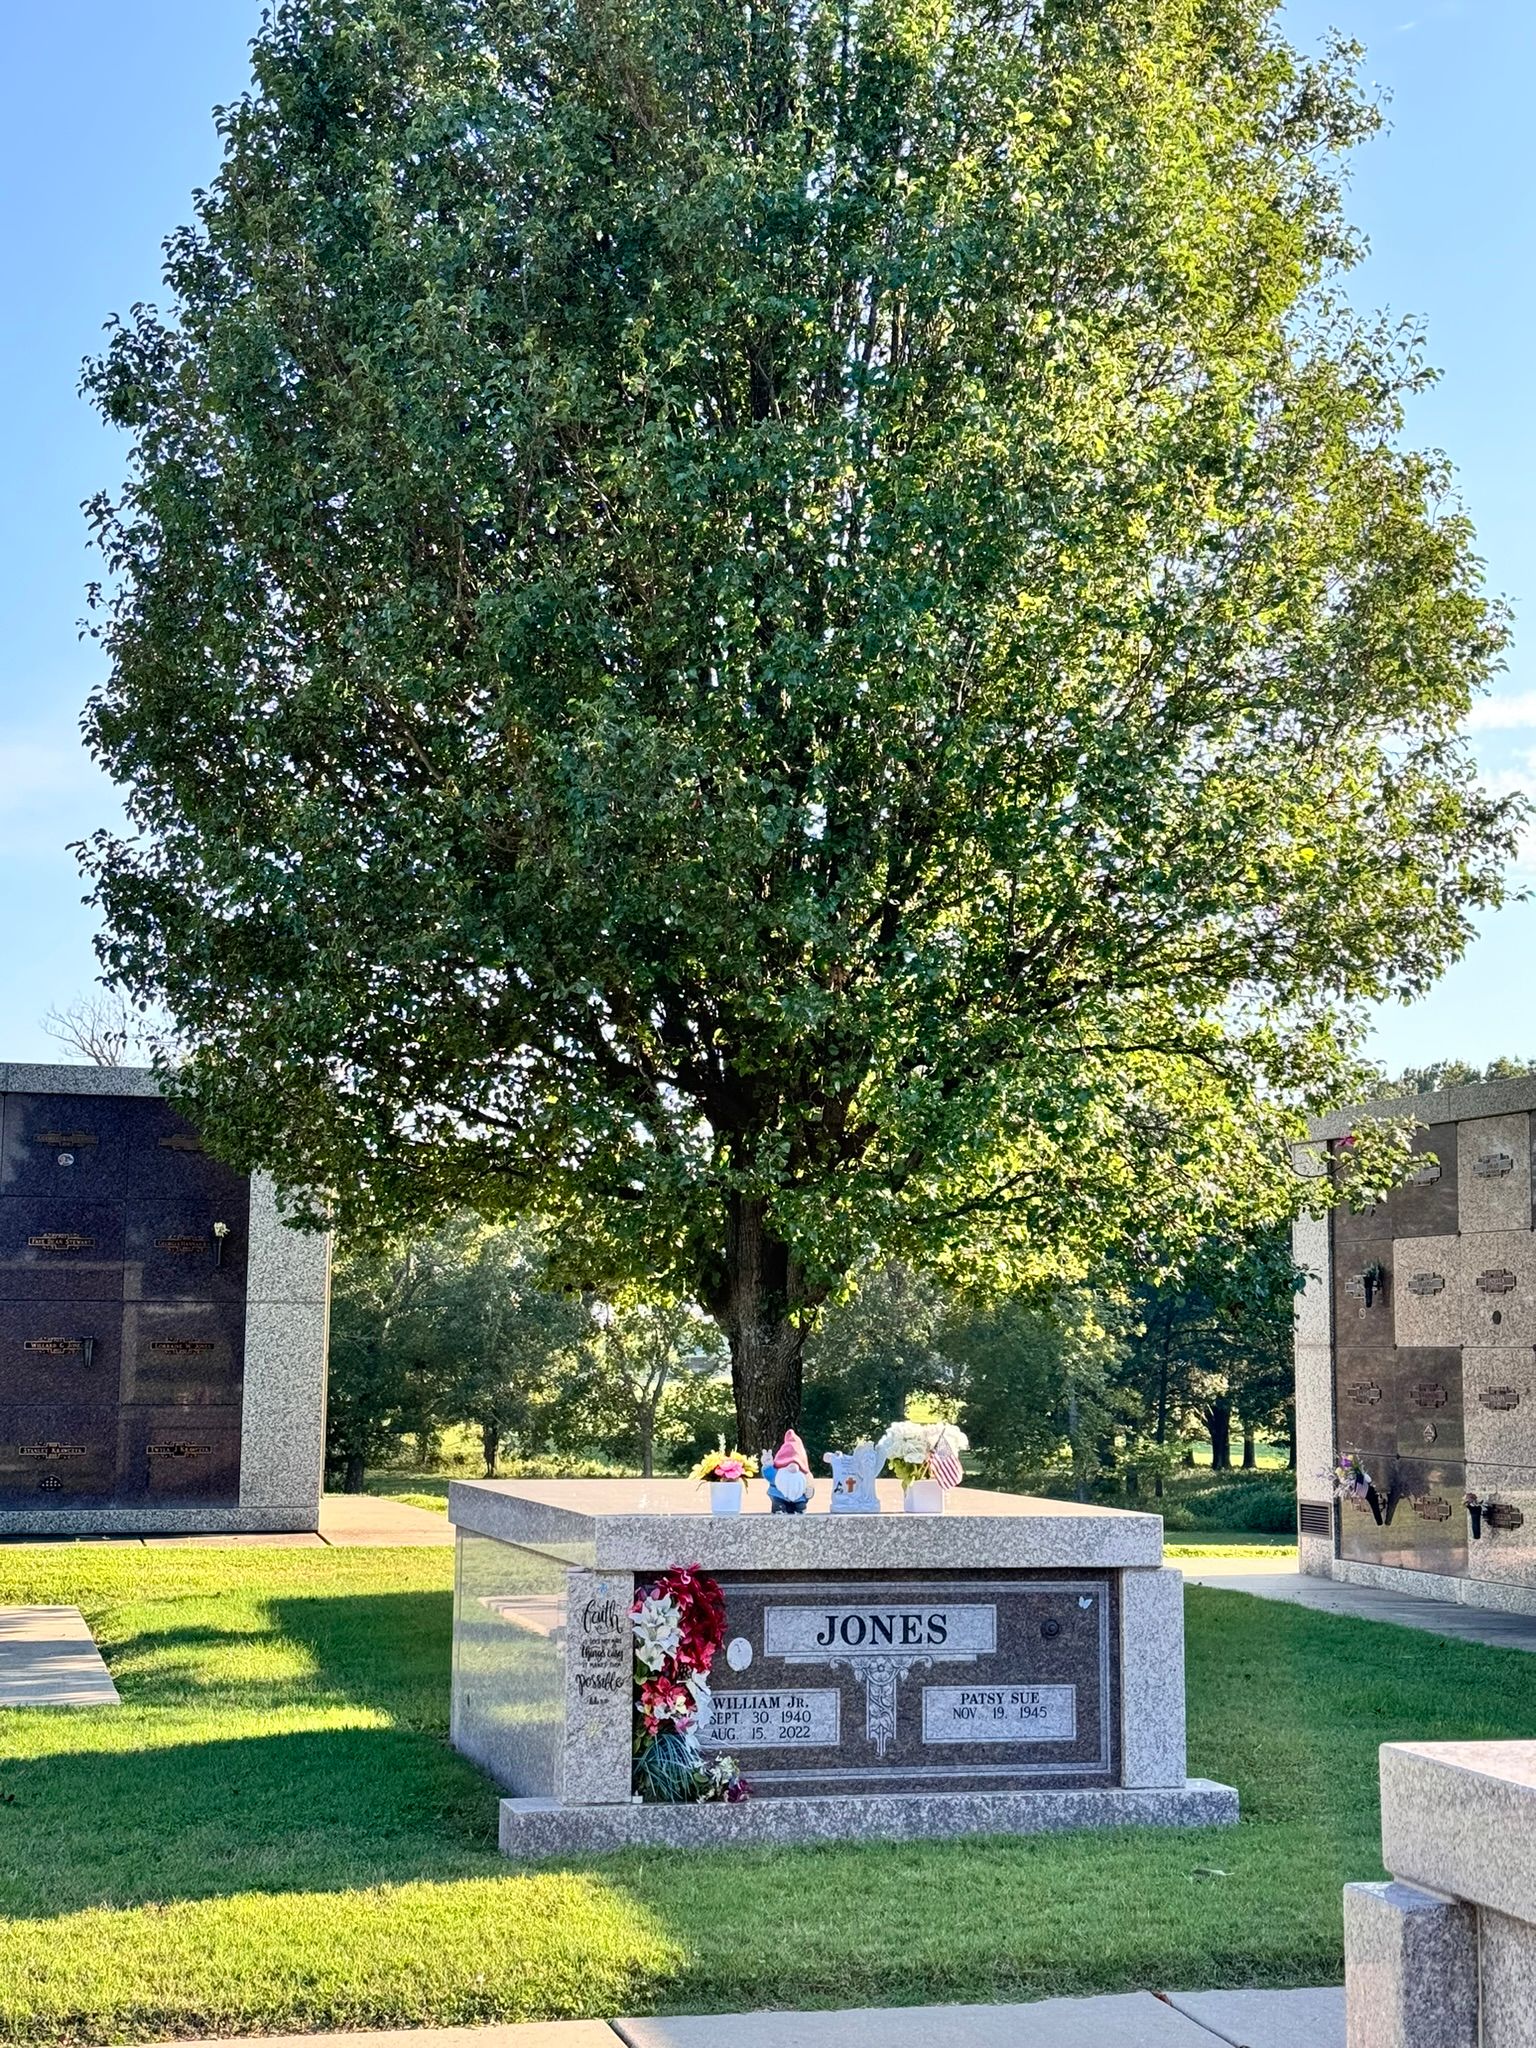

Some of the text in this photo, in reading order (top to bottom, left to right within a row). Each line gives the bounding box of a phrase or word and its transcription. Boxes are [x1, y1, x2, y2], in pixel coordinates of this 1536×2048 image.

[816, 1613, 948, 1646] JONES
[713, 1696, 781, 1710] WILLIAM
[960, 1692, 1040, 1705] PATSY SUE
[781, 1710, 812, 1723] 1940
[1019, 1706, 1048, 1719] 1945
[709, 1727, 739, 1741] AUG.
[779, 1726, 811, 1739] 2022
